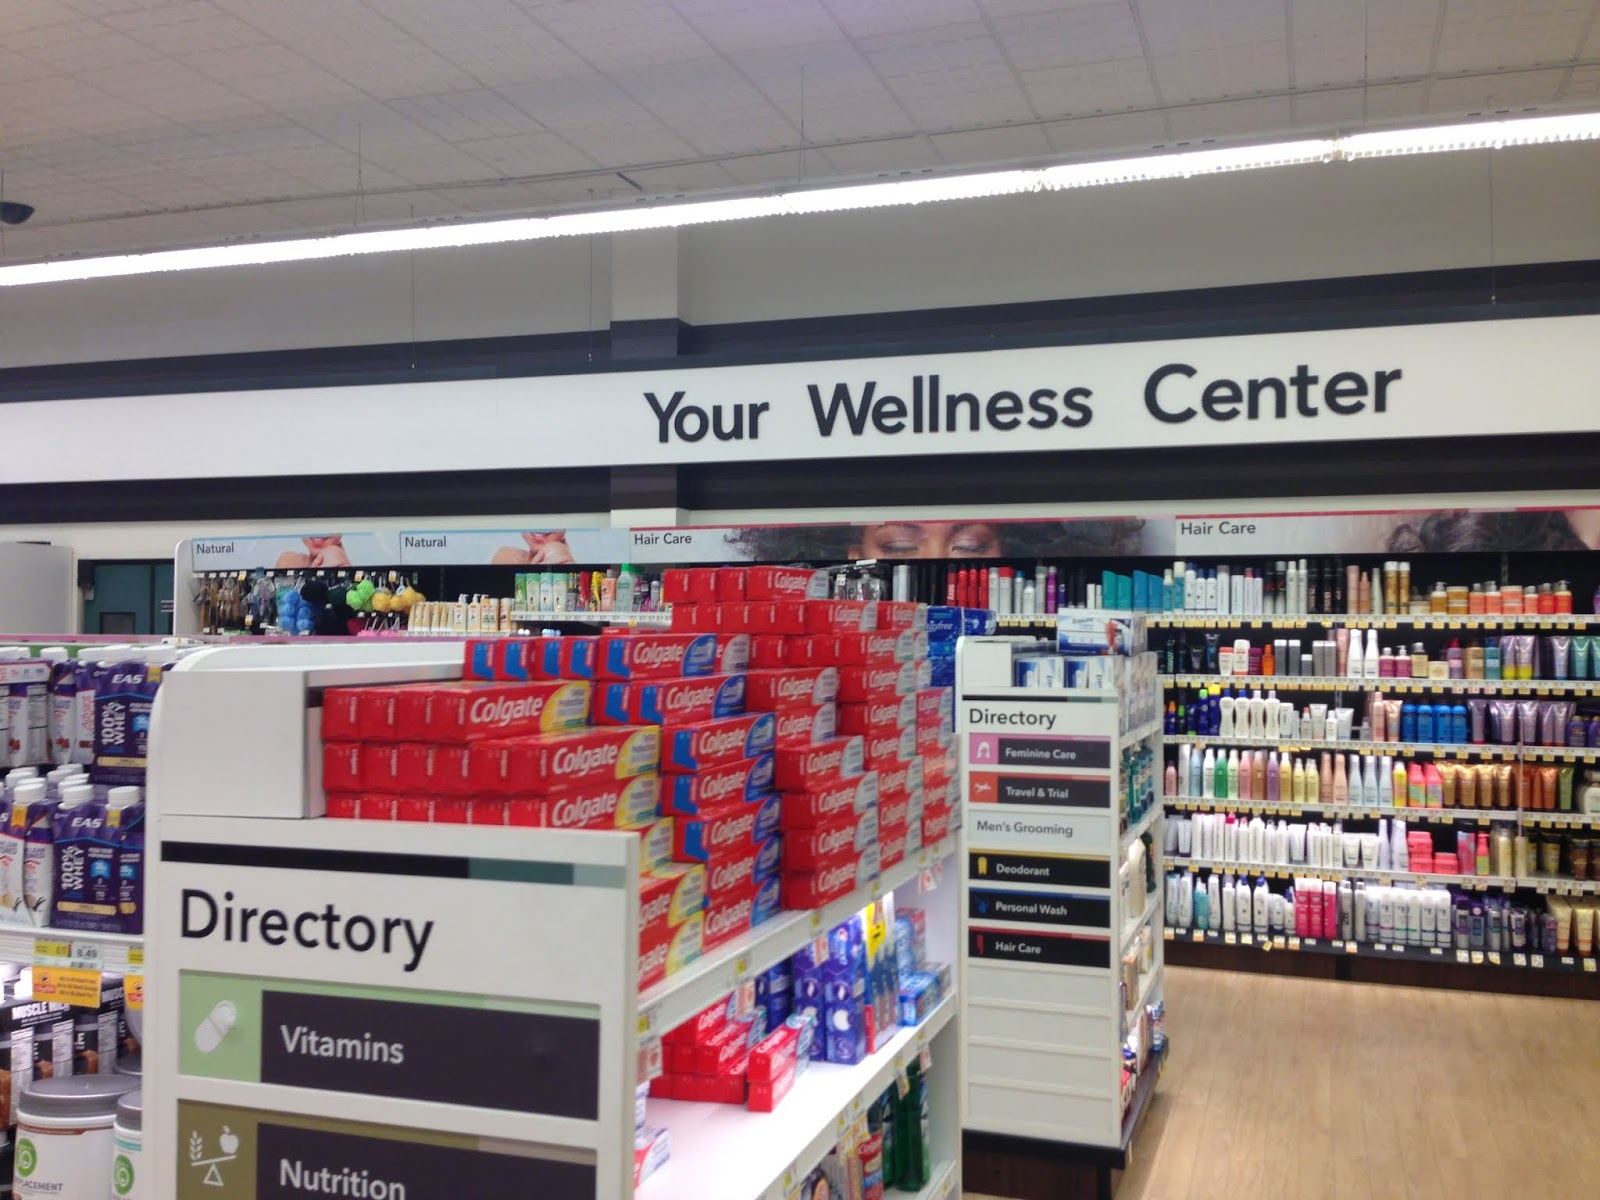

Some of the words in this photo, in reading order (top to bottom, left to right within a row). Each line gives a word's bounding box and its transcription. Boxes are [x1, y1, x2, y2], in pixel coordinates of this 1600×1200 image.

[643, 391, 770, 444] Your
[806, 374, 1093, 438] Wellness
[1143, 363, 1403, 425] Center
[634, 533, 660, 545] Hair
[663, 532, 692, 545] Care
[1181, 521, 1214, 535] Hair
[1218, 520, 1257, 535] Care
[196, 542, 235, 554] Natural
[404, 535, 447, 548] Natural
[775, 571, 807, 592] Colgate
[633, 640, 683, 668] Colgate
[112, 674, 143, 684] EAS
[777, 677, 814, 699] Colgate
[666, 685, 716, 714] Colgate
[470, 695, 544, 727] Colgate
[969, 708, 1057, 730] Directory
[777, 716, 812, 738] Colgate
[701, 727, 746, 756] Colgate
[552, 743, 619, 776] Colgate
[1005, 747, 1051, 759] Feminine
[1052, 749, 1077, 760] Care
[701, 769, 746, 799] Colgate
[1006, 785, 1035, 798] Travel
[1036, 787, 1046, 798] &
[1047, 787, 1069, 799] Trial
[551, 792, 618, 828] Colgate
[71, 817, 103, 829] EAS
[711, 813, 754, 845] Colgate
[976, 820, 1012, 833] Men's
[1013, 821, 1074, 839] Grooming
[711, 856, 754, 890] Colgate
[995, 863, 1050, 877] Deodorant
[705, 899, 751, 936] Colgate
[995, 901, 1037, 914] Personal
[1038, 904, 1068, 916] Wash
[180, 888, 434, 973] Directory
[995, 941, 1016, 952] Hair
[1017, 943, 1042, 955] Care
[280, 1024, 404, 1065] Vitamins
[279, 1158, 406, 1200] Nutrition
